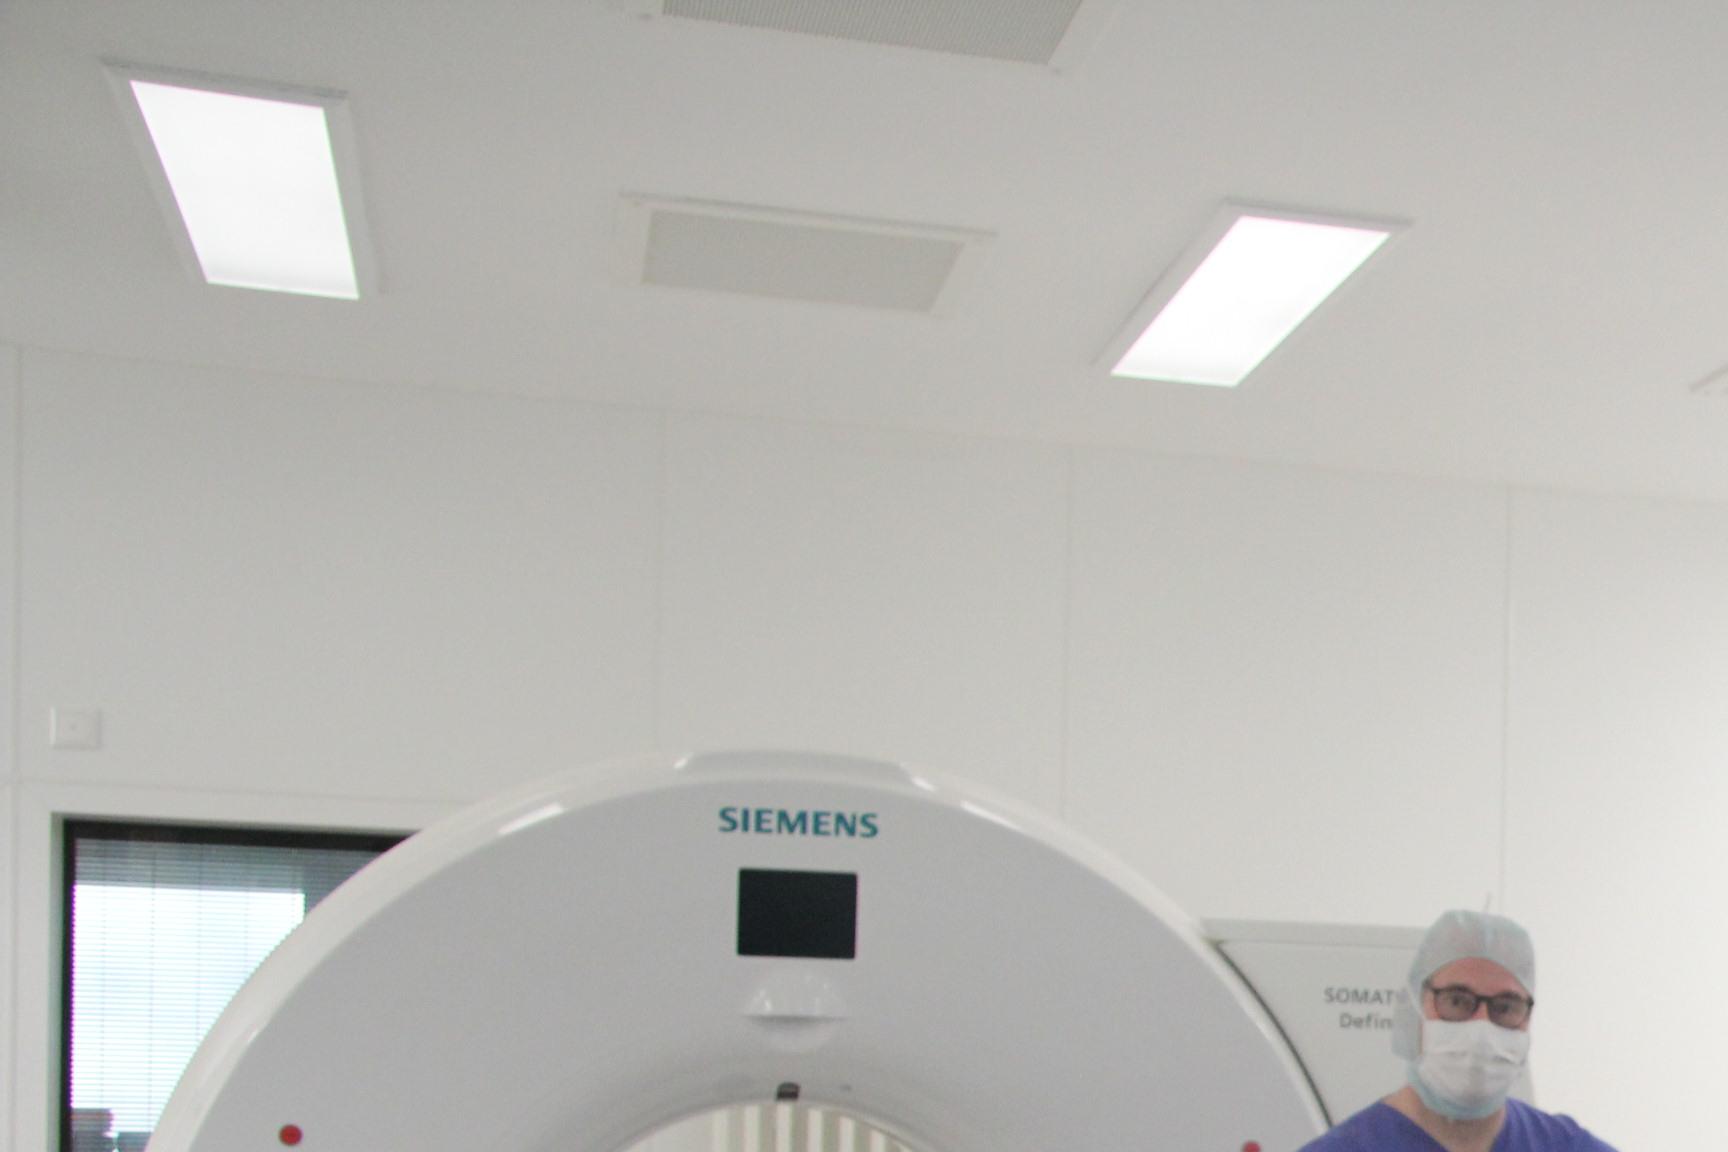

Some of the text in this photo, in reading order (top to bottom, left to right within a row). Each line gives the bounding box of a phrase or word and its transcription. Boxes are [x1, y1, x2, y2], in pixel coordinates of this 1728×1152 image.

[718, 805, 880, 839] SIEMENS
[1323, 986, 1394, 1005] SOMAT
[1339, 1012, 1393, 1029] Defin
